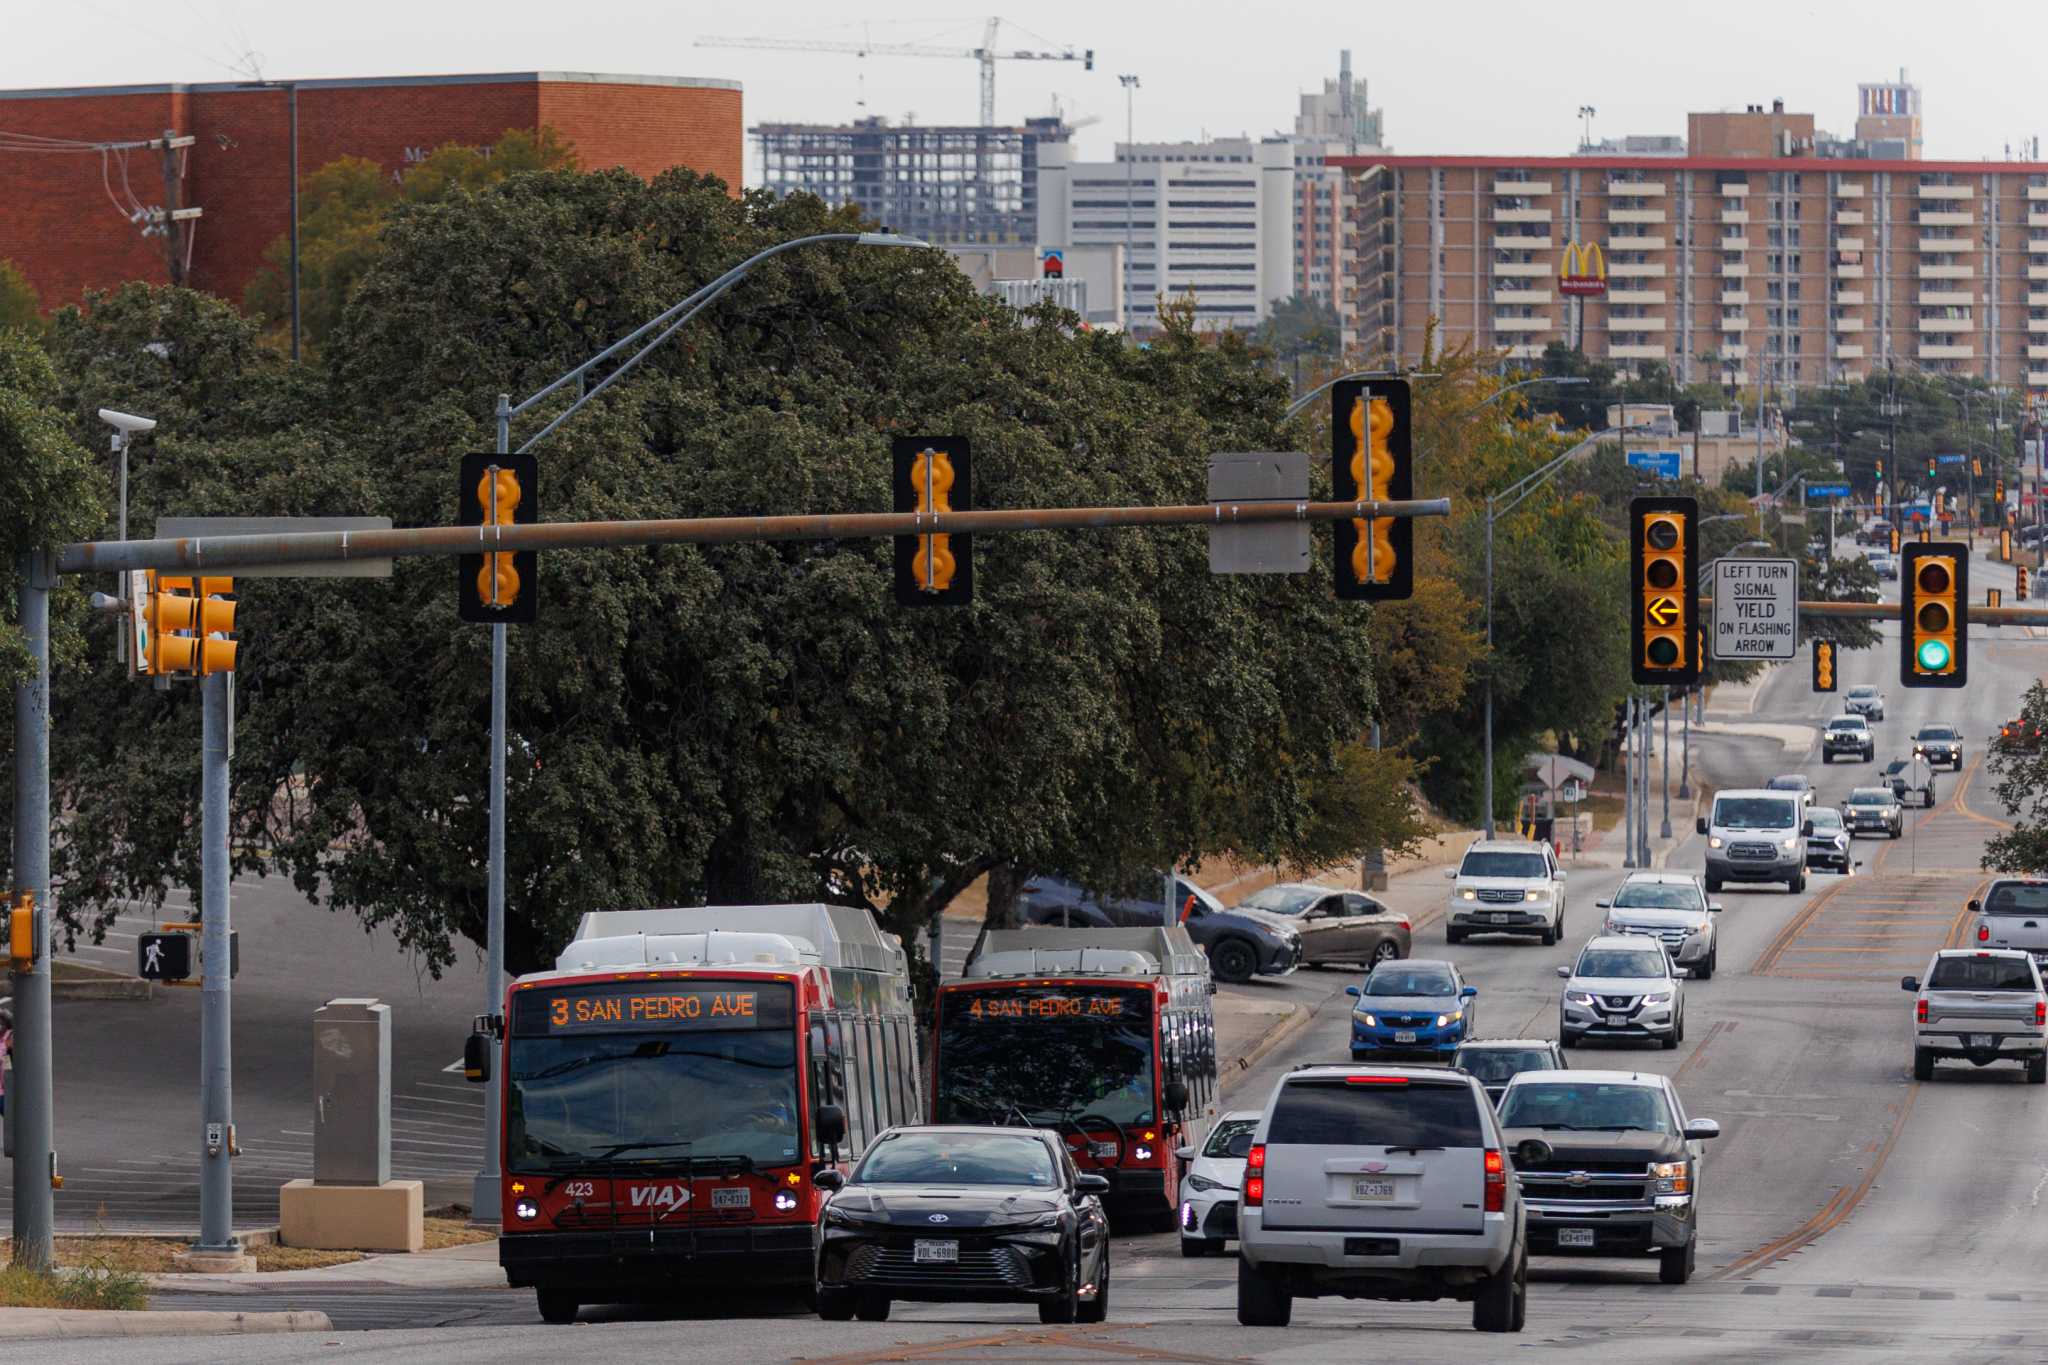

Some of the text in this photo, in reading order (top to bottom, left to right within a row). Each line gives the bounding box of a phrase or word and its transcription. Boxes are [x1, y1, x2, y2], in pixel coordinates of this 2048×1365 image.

[1723, 566, 1788, 579] LEFT TURN
[1734, 583, 1777, 596] SIGNAL
[1735, 602, 1775, 618] YIELD
[1719, 622, 1791, 635] ON FLASHING
[1734, 640, 1775, 652] ARROW
[551, 993, 754, 1026] 3 SAN PEDRO AVE
[969, 996, 1121, 1021] 4 SAN PEDRO AVE
[564, 1182, 594, 1197] 423
[630, 1185, 675, 1206] VIA
